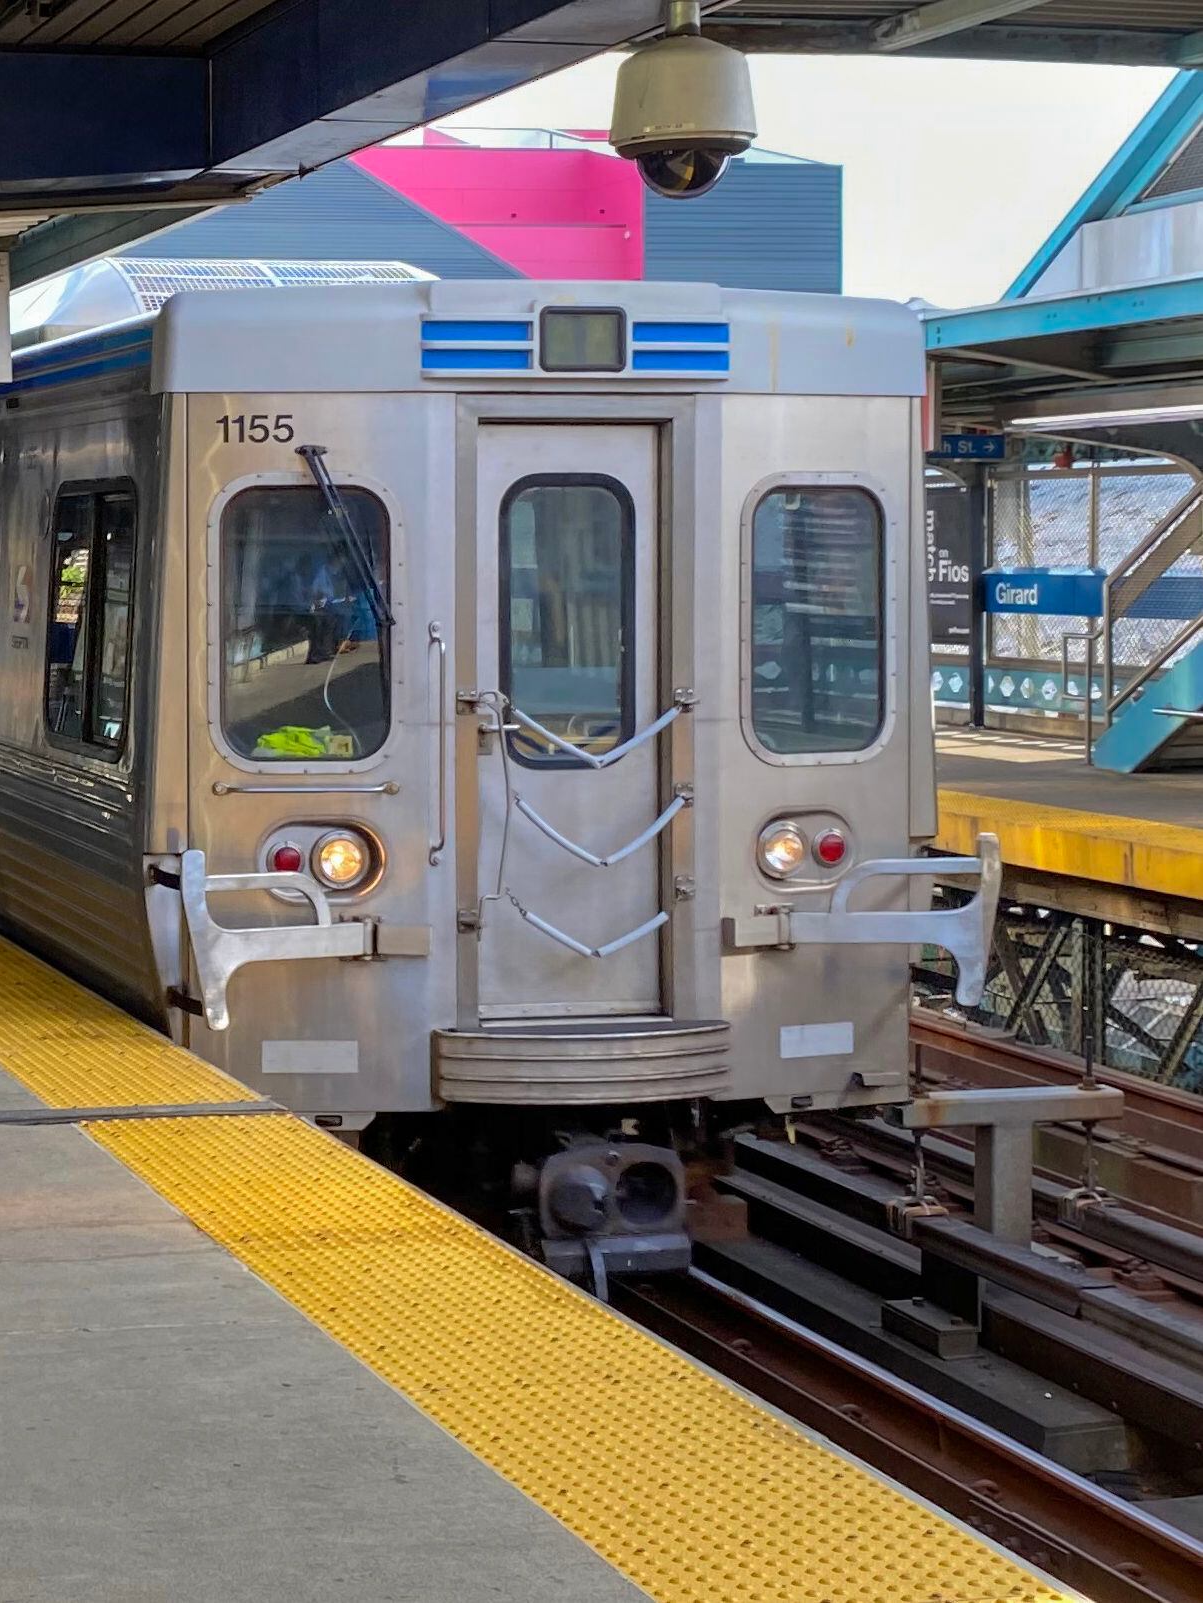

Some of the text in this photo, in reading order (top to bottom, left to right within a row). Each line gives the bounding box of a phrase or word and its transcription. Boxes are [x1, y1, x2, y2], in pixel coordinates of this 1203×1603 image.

[216, 415, 294, 443] 1155
[939, 560, 969, 582] Fios
[996, 582, 1038, 605] Girard
